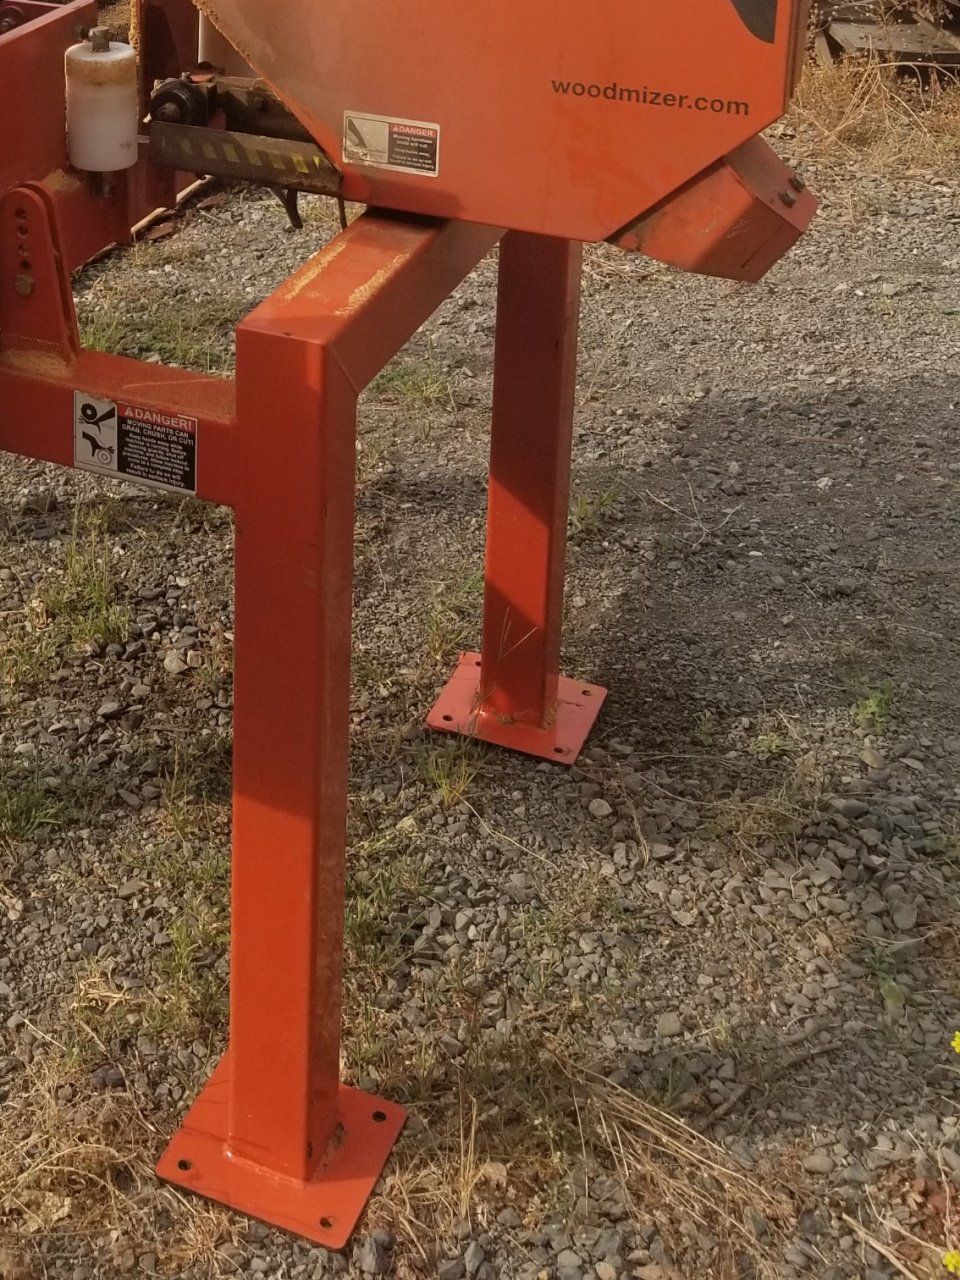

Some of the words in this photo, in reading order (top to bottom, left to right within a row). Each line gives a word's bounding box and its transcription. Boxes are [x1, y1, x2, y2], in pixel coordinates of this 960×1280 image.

[551, 79, 750, 116] woodmizer.com
[400, 125, 434, 136] DANGER
[127, 419, 151, 430] MOVING
[154, 425, 173, 434] PARTS
[175, 430, 188, 438] CAN
[136, 409, 191, 430] DANGER!
